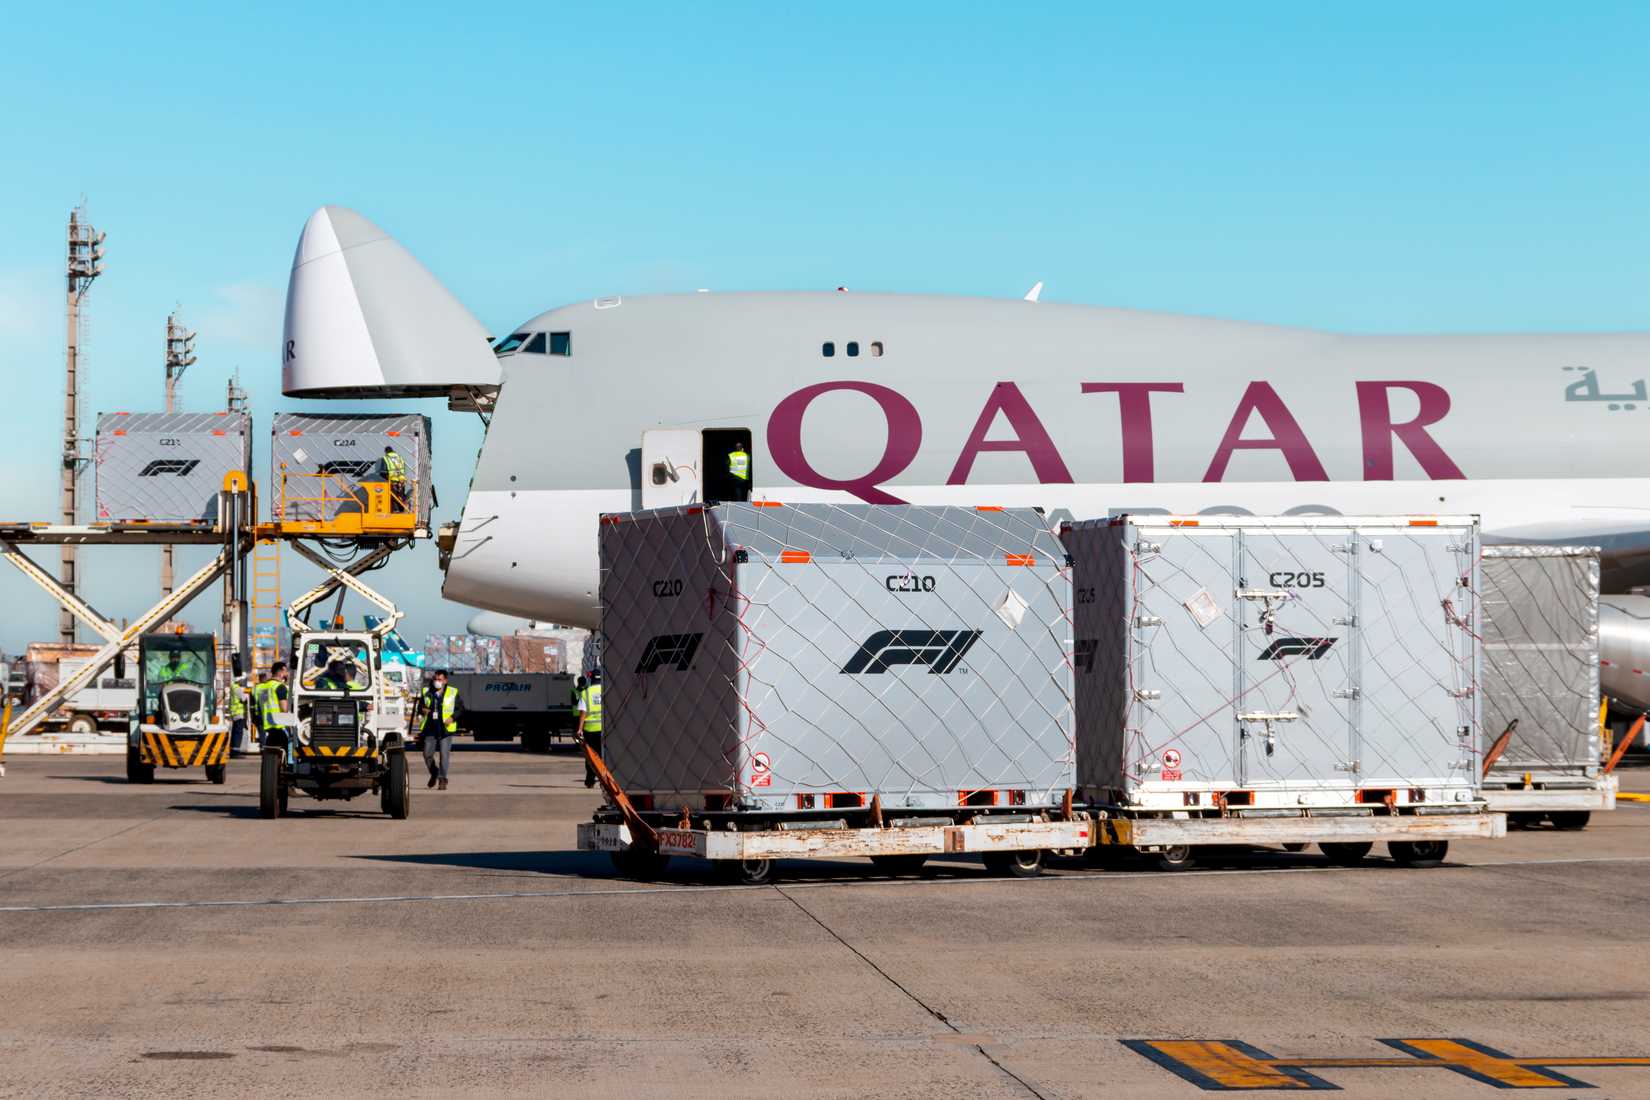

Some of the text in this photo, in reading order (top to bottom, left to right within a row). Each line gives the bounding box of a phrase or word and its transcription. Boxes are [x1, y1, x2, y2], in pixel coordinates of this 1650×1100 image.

[766, 380, 1467, 505] QATAR
[652, 579, 683, 598] C210
[885, 575, 936, 593] C210
[1269, 572, 1325, 588] C205
[839, 629, 984, 674] F1
